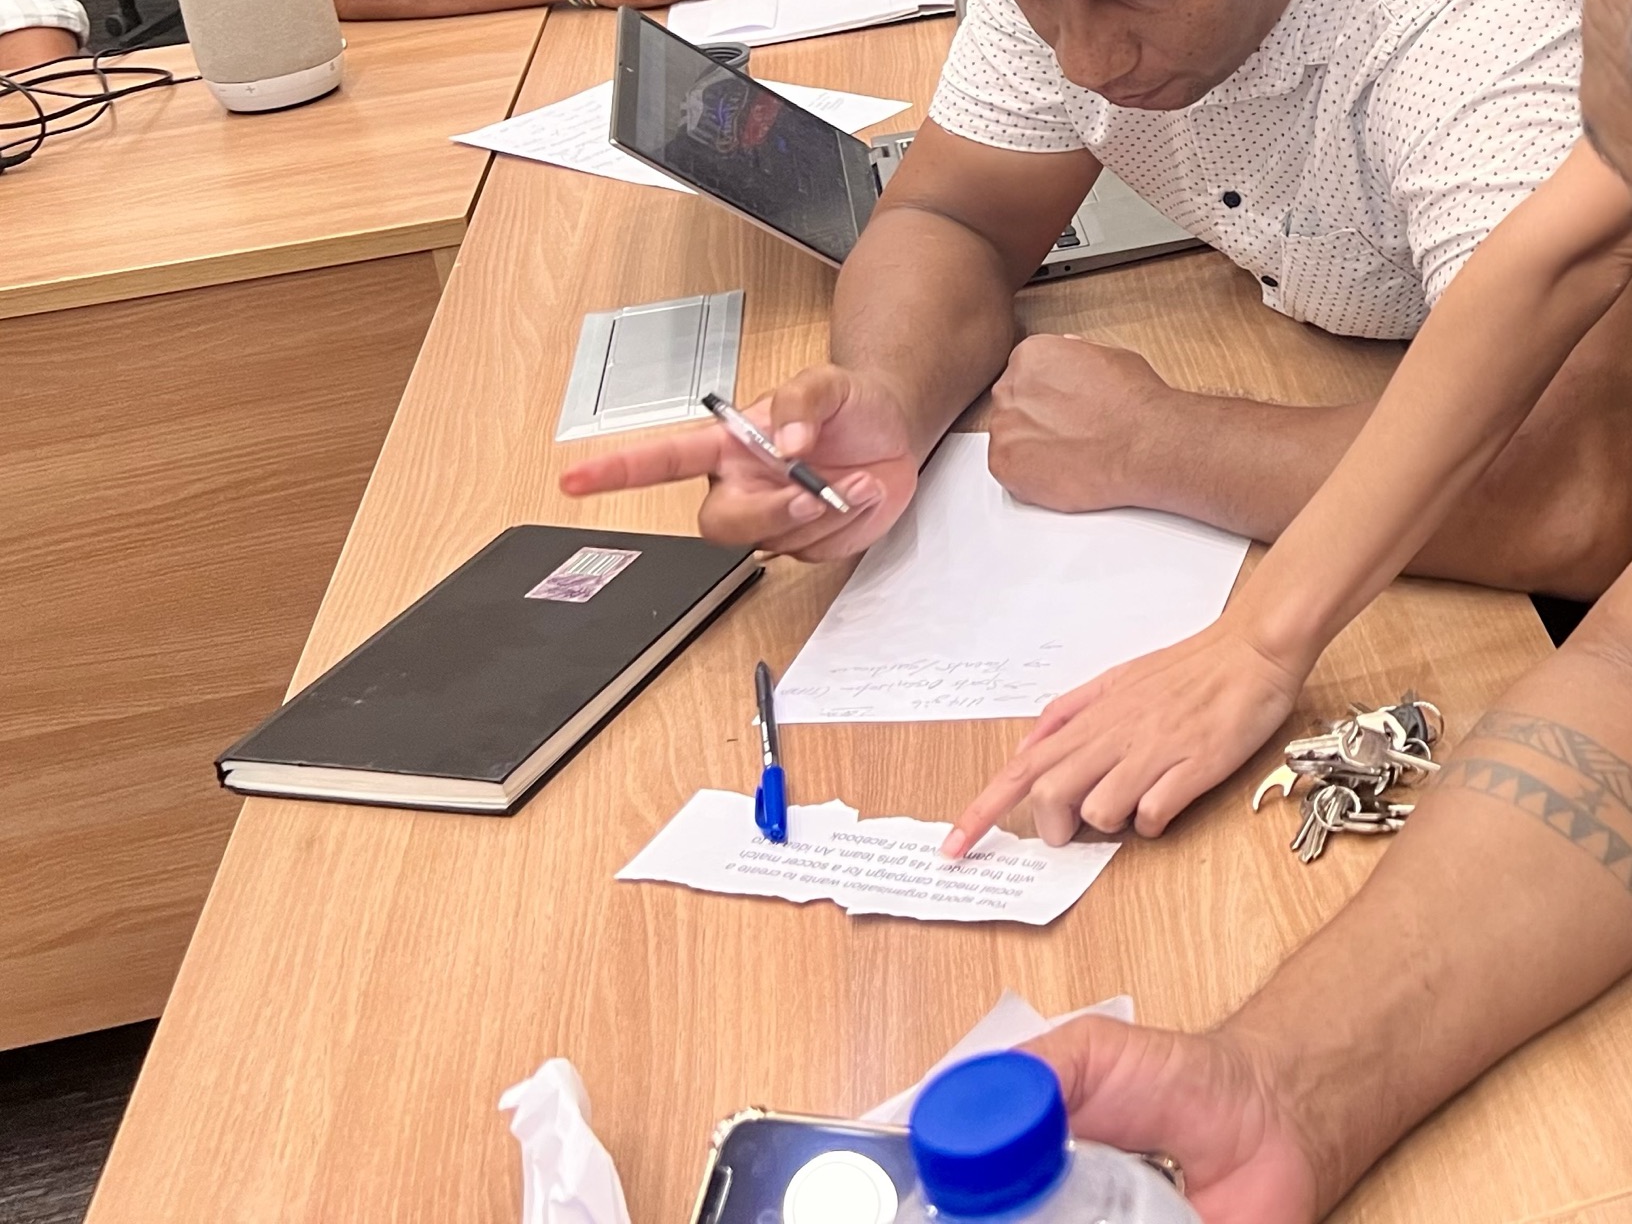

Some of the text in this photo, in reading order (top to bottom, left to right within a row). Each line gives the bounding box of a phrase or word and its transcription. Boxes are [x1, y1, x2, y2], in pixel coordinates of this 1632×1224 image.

[831, 832, 898, 850] Facebook
[815, 846, 835, 856] An
[899, 843, 917, 852] on
[739, 850, 782, 864] match
[877, 855, 908, 867] girls
[963, 852, 995, 862] gam
[996, 856, 1020, 867] the
[782, 857, 830, 870] soccer
[909, 859, 933, 871] 14s
[1022, 859, 1048, 871] film
[738, 865, 781, 877] create
[783, 872, 798, 881] to
[843, 866, 863, 877] for
[866, 868, 934, 886] campaign
[936, 865, 978, 877] under
[980, 869, 1004, 881] the
[800, 874, 840, 886] wants
[1006, 873, 1035, 885] with
[844, 881, 929, 900] organisation
[936, 880, 980, 892] media
[980, 886, 1024, 897] social
[931, 892, 975, 904] sports
[976, 898, 1007, 909] Your
